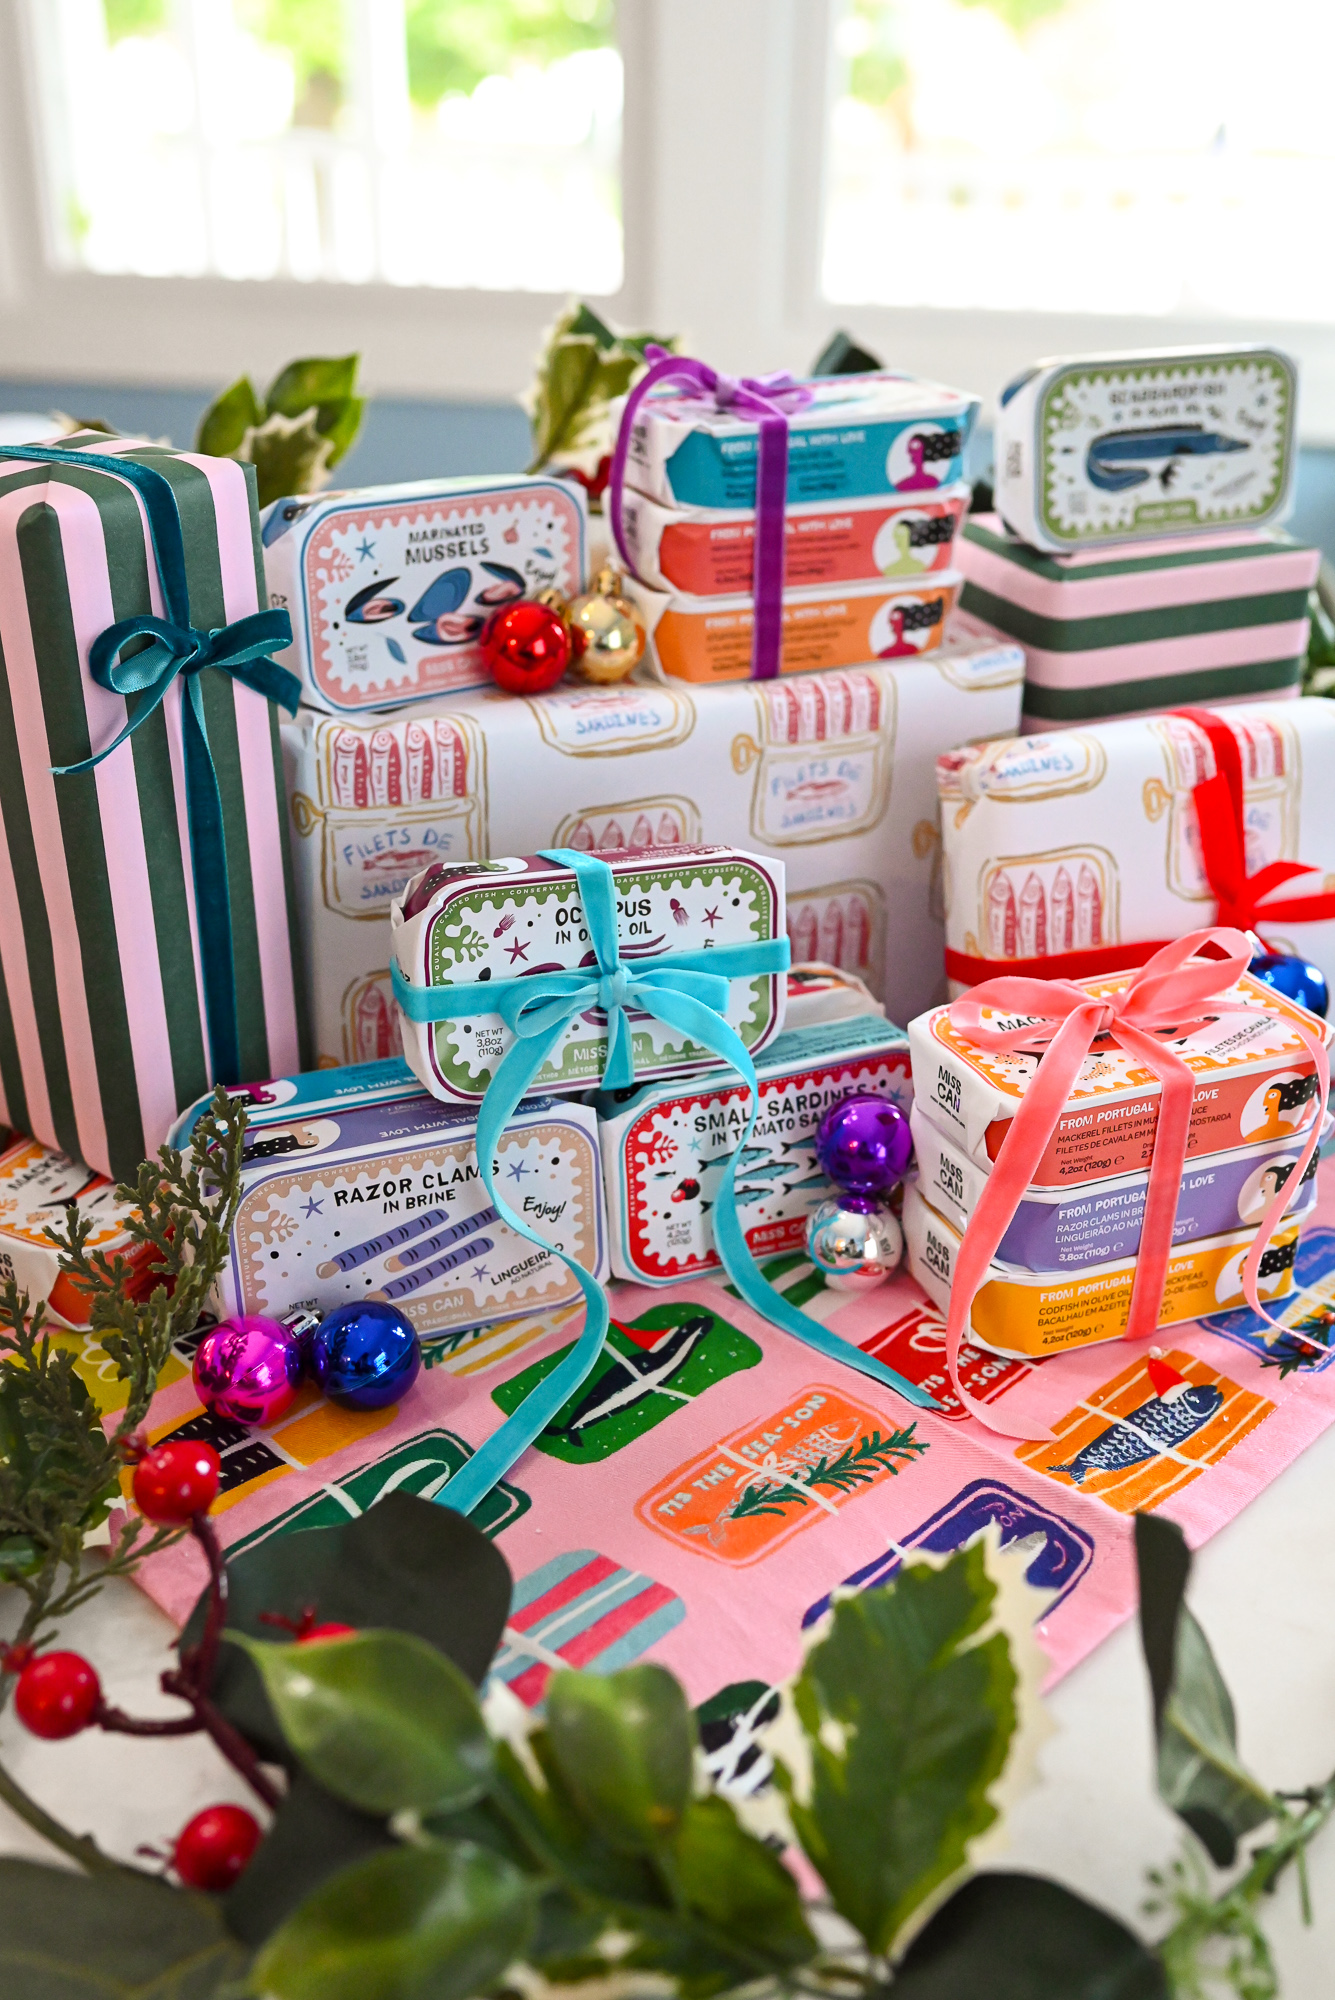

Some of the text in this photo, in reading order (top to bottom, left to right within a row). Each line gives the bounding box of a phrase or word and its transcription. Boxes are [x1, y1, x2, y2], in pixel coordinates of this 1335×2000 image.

[408, 522, 485, 544] MARINATED
[404, 538, 490, 566] MUSSELS
[576, 709, 662, 735] SARDINES
[342, 828, 453, 866] FILETS DE
[438, 896, 470, 924] CANNED
[474, 890, 498, 900] FISH
[509, 884, 567, 896] CONSERVAS
[645, 870, 691, 881] SUPERIOR
[702, 866, 750, 877] CONSERVES
[749, 873, 760, 884] DE
[555, 931, 572, 945] IN
[629, 920, 652, 936] OIL
[475, 1027, 504, 1039] NET WT
[476, 1037, 502, 1048] 3,8oz
[478, 1045, 504, 1058] (110g)
[573, 1045, 607, 1063] MISS
[938, 1065, 961, 1096] MISS
[937, 1083, 961, 1113] CAN
[1059, 1088, 1219, 1130] FROM PORTUGAL LOVE
[379, 1126, 411, 1139] LOVE
[414, 1119, 450, 1132] WITH
[1055, 1112, 1232, 1155] FILETES DE CAVALA EM MOSTARDA
[1057, 1129, 1100, 1144] MACKEREL
[1102, 1121, 1133, 1135] FILLETS
[1134, 1119, 1143, 1128] IN
[1191, 1106, 1208, 1116] UCE
[712, 1132, 727, 1146] IN
[940, 1153, 963, 1183] MISS
[1059, 1158, 1112, 1175] 4,2oz (120g)
[1073, 1155, 1093, 1165] Weight
[334, 1160, 500, 1208] RAZOR CLAMS
[939, 1169, 963, 1200] CAN
[1058, 1173, 1215, 1220] FROM PORTUGA LOVE
[239, 1215, 248, 1254] QUALITY
[280, 1177, 303, 1185] FISH
[317, 1163, 376, 1178] CONSERVAS
[381, 1158, 393, 1166] DE
[398, 1147, 454, 1163] QUALIDADE
[383, 1188, 456, 1214] IN BRINE
[523, 1196, 567, 1223] Enjoy!
[1055, 1222, 1126, 1244] LINGUEIRÃO AO
[1056, 1220, 1089, 1233] RAZOR
[1089, 1212, 1120, 1226] CLAMS
[1121, 1208, 1131, 1218] IN
[927, 1230, 950, 1261] MISS
[1058, 1245, 1110, 1262] 3,8oz (110g)
[1073, 1242, 1094, 1252] Weight
[926, 1246, 950, 1278] CAN
[1040, 1260, 1195, 1303] FROM PORTUGAL LOVE
[288, 1301, 304, 1310] NET
[399, 1295, 464, 1318] ISS CAN
[1037, 1310, 1084, 1327] BACALHAU
[1084, 1308, 1098, 1317] EM
[1098, 1300, 1127, 1313] AZEITE
[1039, 1301, 1080, 1316] CODFISH
[1080, 1299, 1090, 1308] IN
[1090, 1293, 1116, 1306] OLIVE
[1117, 1289, 1131, 1299] OIL
[1042, 1327, 1092, 1345] 4,2oz (120g)
[658, 1394, 827, 1517] TIS THE SEA-SON
